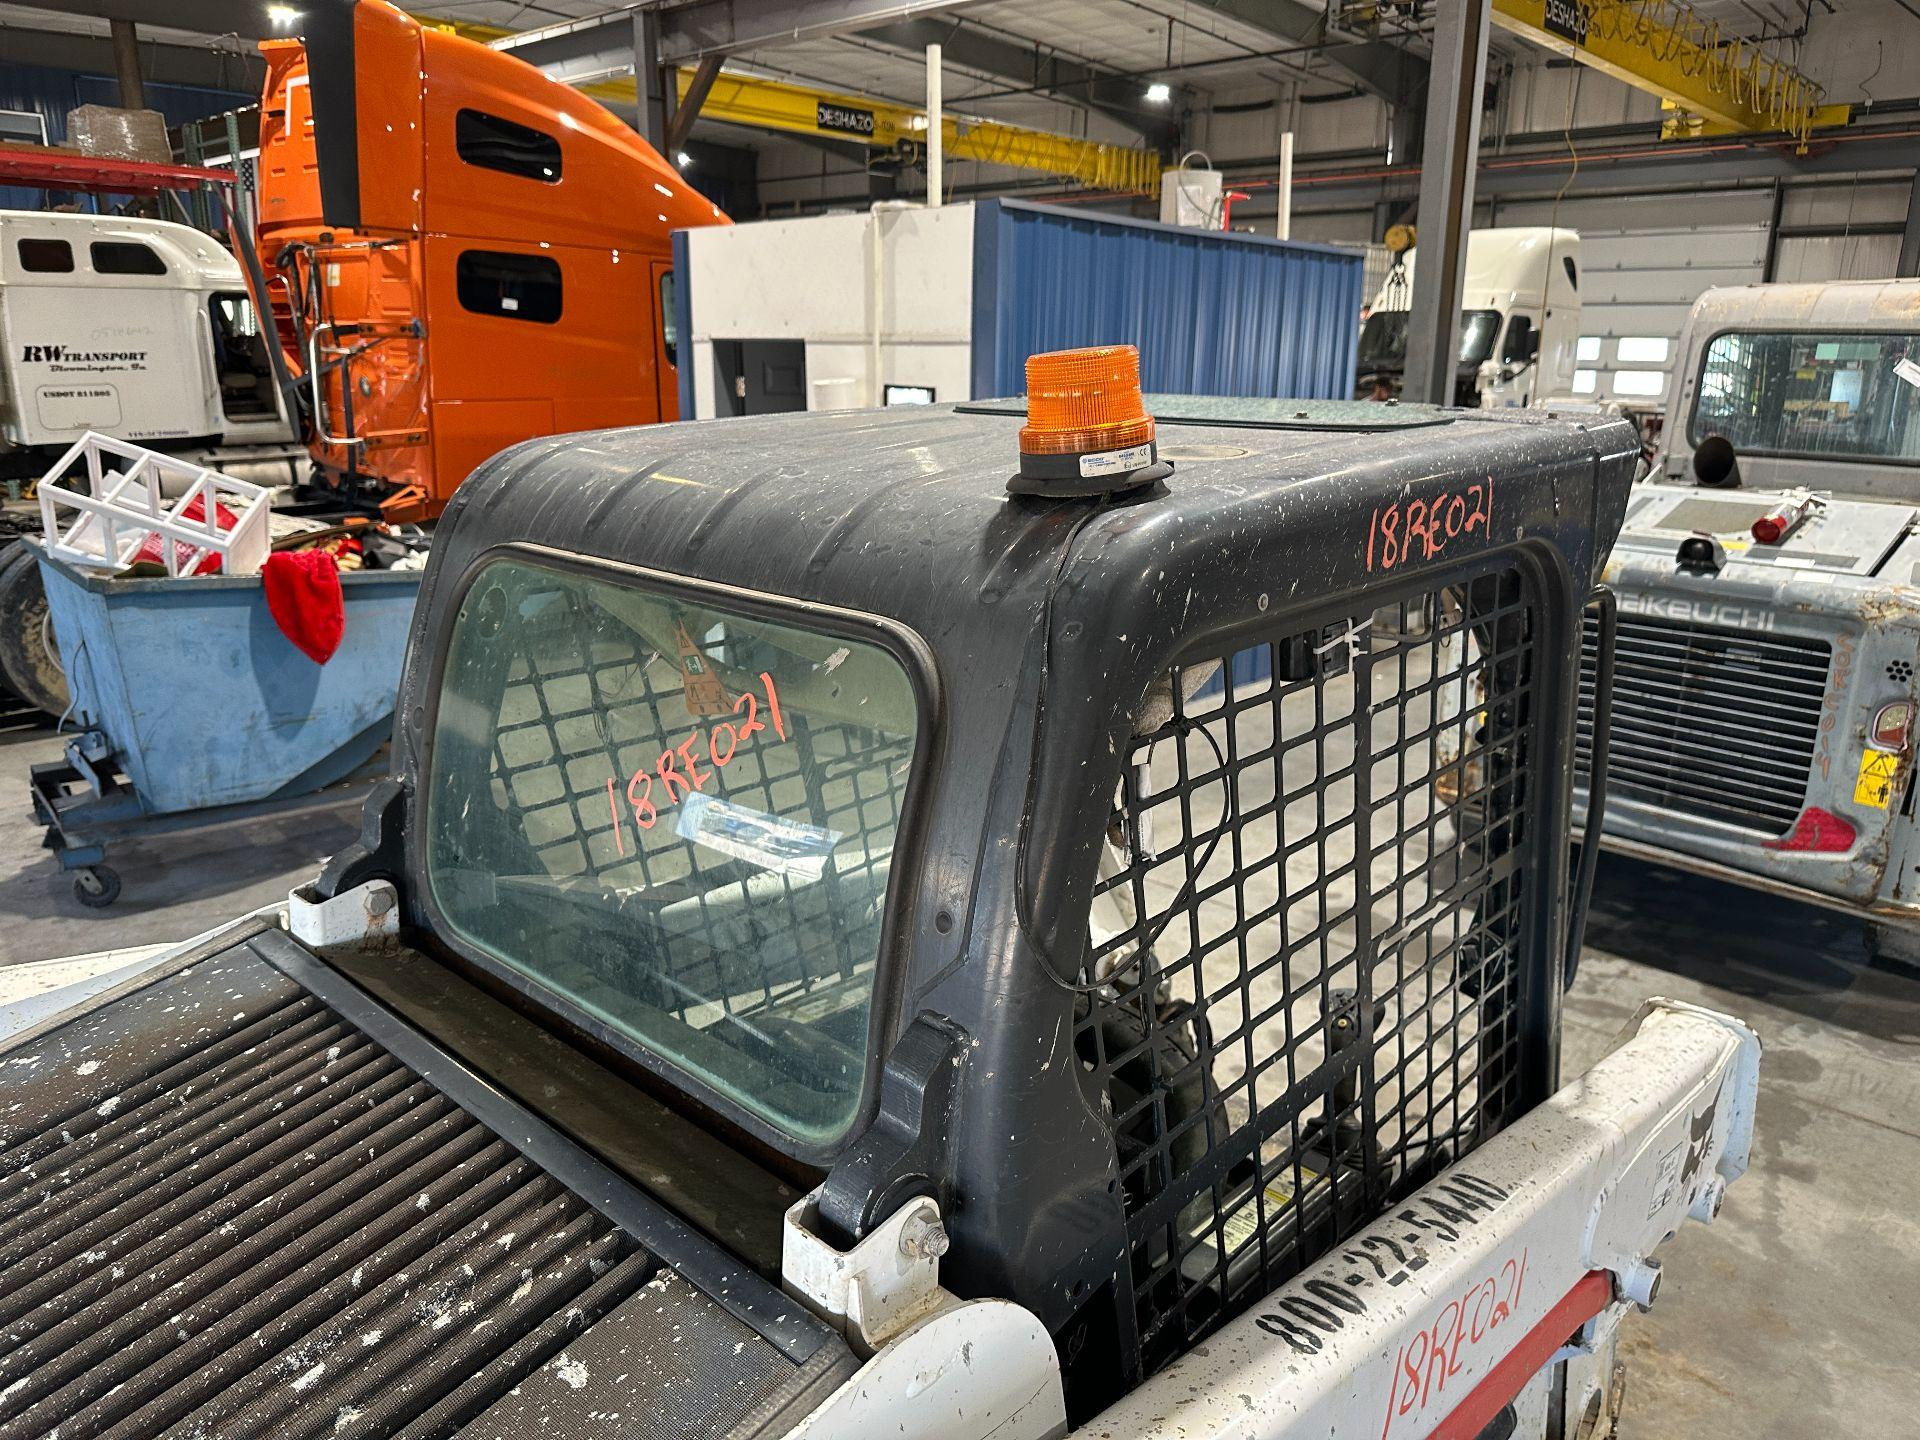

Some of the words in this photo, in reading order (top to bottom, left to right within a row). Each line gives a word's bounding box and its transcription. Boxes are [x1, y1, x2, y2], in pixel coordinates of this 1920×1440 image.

[818, 106, 874, 131] DESHAZO
[22, 345, 68, 362] RW
[63, 351, 148, 362] TRANSPORT
[607, 671, 786, 857] 18RE021
